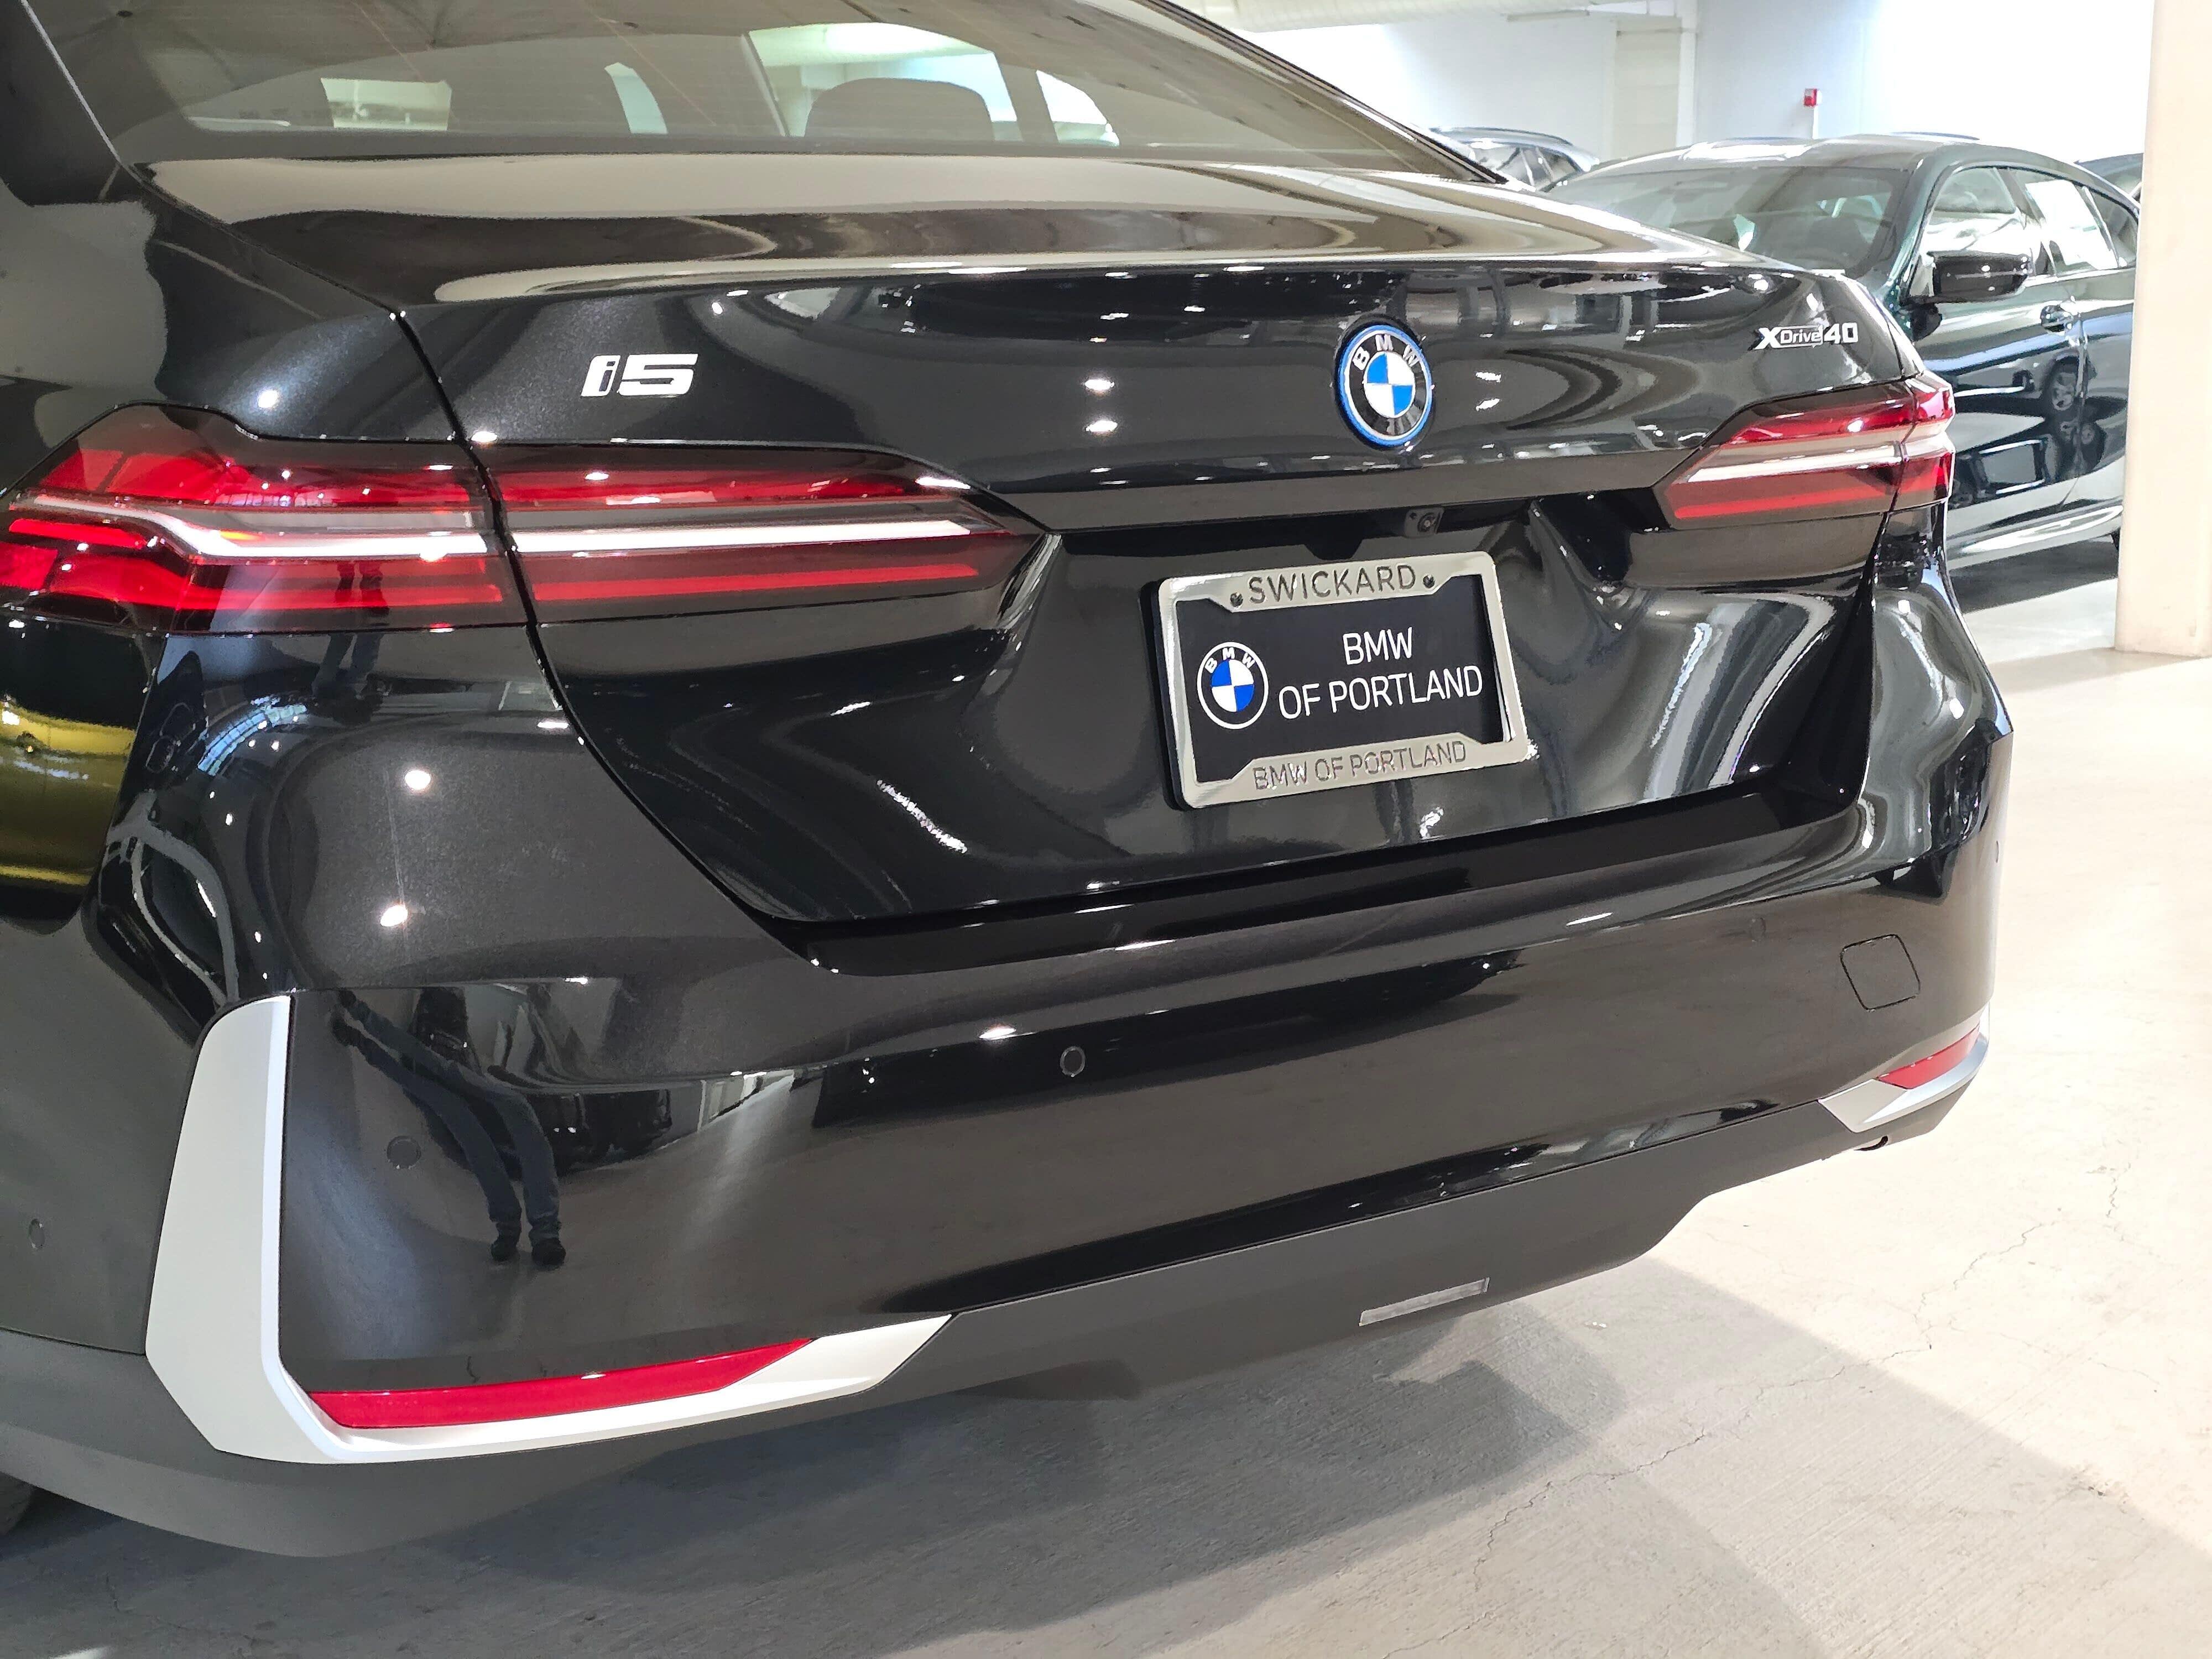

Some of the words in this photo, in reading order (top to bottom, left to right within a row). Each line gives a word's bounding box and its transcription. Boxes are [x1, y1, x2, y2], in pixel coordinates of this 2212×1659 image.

[1352, 333, 1421, 371] BMW
[581, 353, 698, 398] i5
[1248, 564, 1416, 604] SWICKARD
[1204, 646, 1256, 674] BMW
[1343, 627, 1412, 665] BMW
[1278, 683, 1321, 719] OF
[1328, 665, 1483, 713] PORTLAND
[1252, 760, 1307, 791] BMW
[1314, 756, 1344, 782] OF
[1349, 740, 1467, 778] PORTLAND
